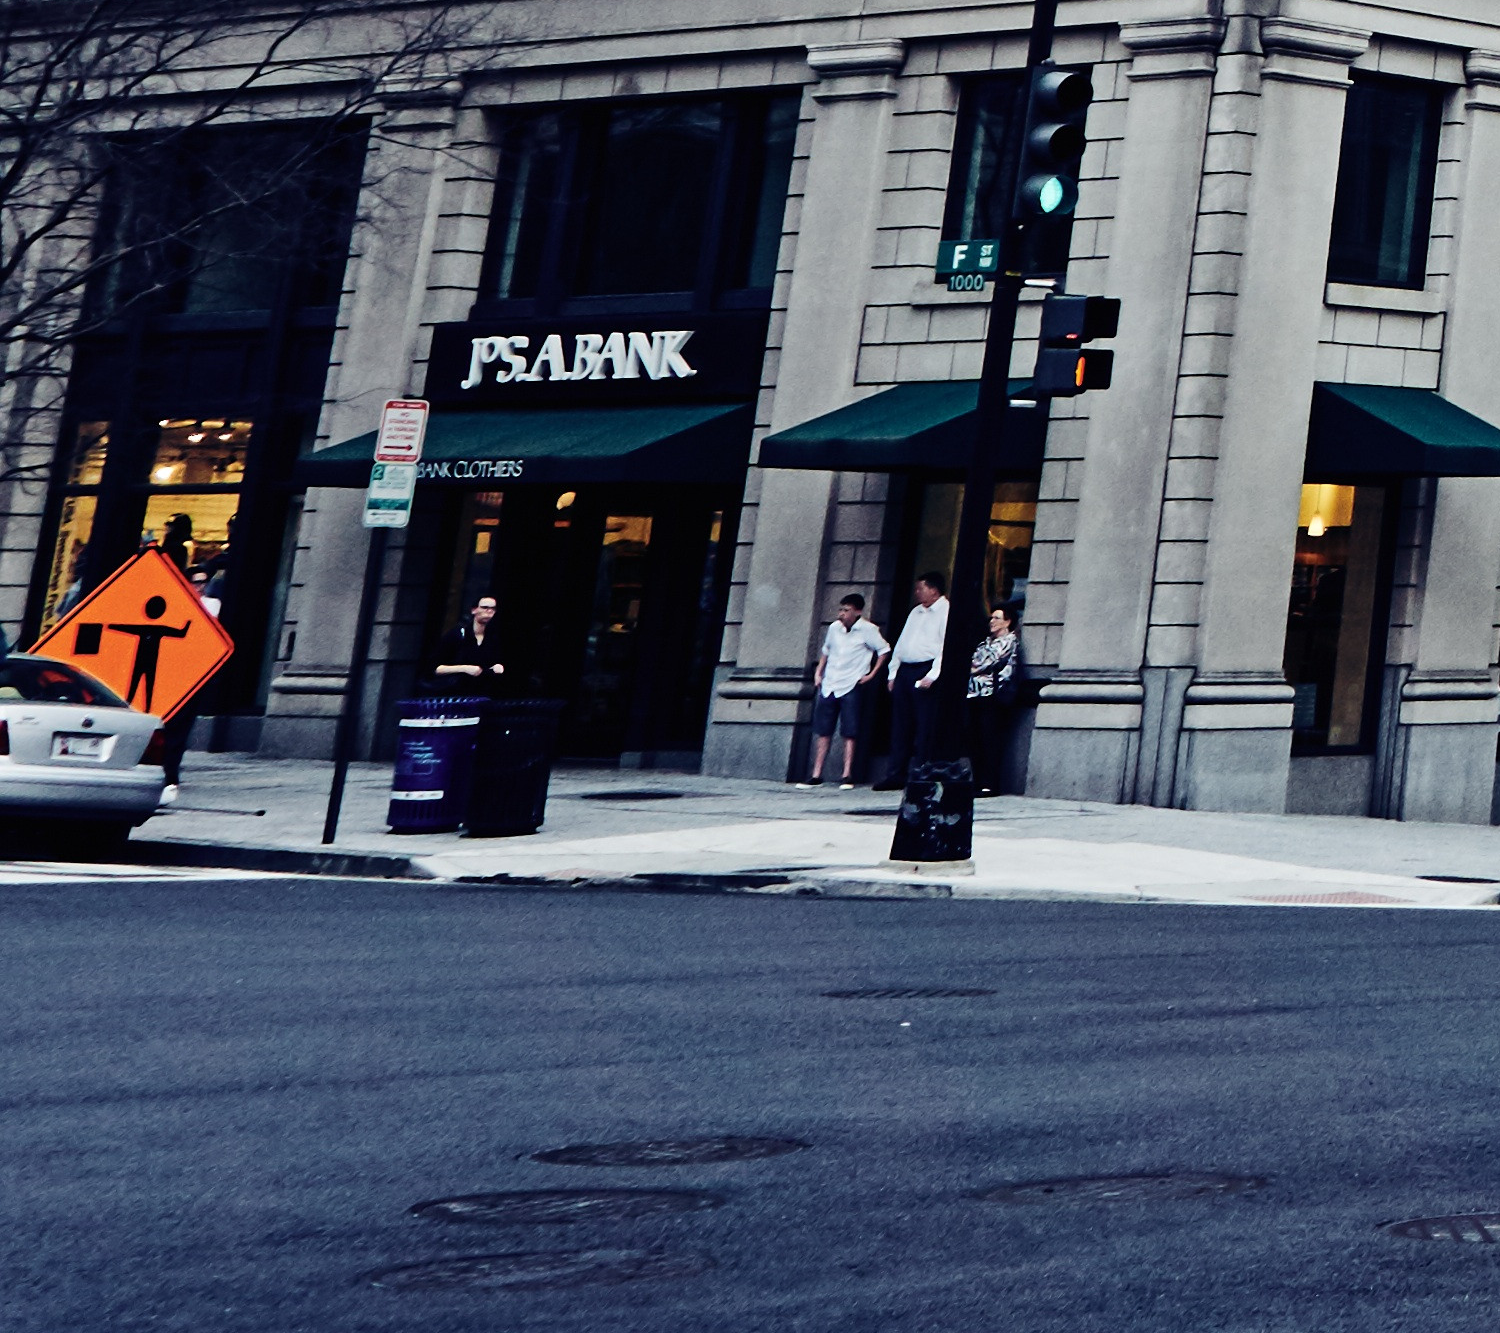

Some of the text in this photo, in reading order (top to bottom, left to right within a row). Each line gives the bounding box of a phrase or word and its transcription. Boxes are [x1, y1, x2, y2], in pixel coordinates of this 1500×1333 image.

[952, 244, 994, 270] F ST
[950, 274, 984, 291] 1000
[454, 459, 524, 479] CLOTHIERS
